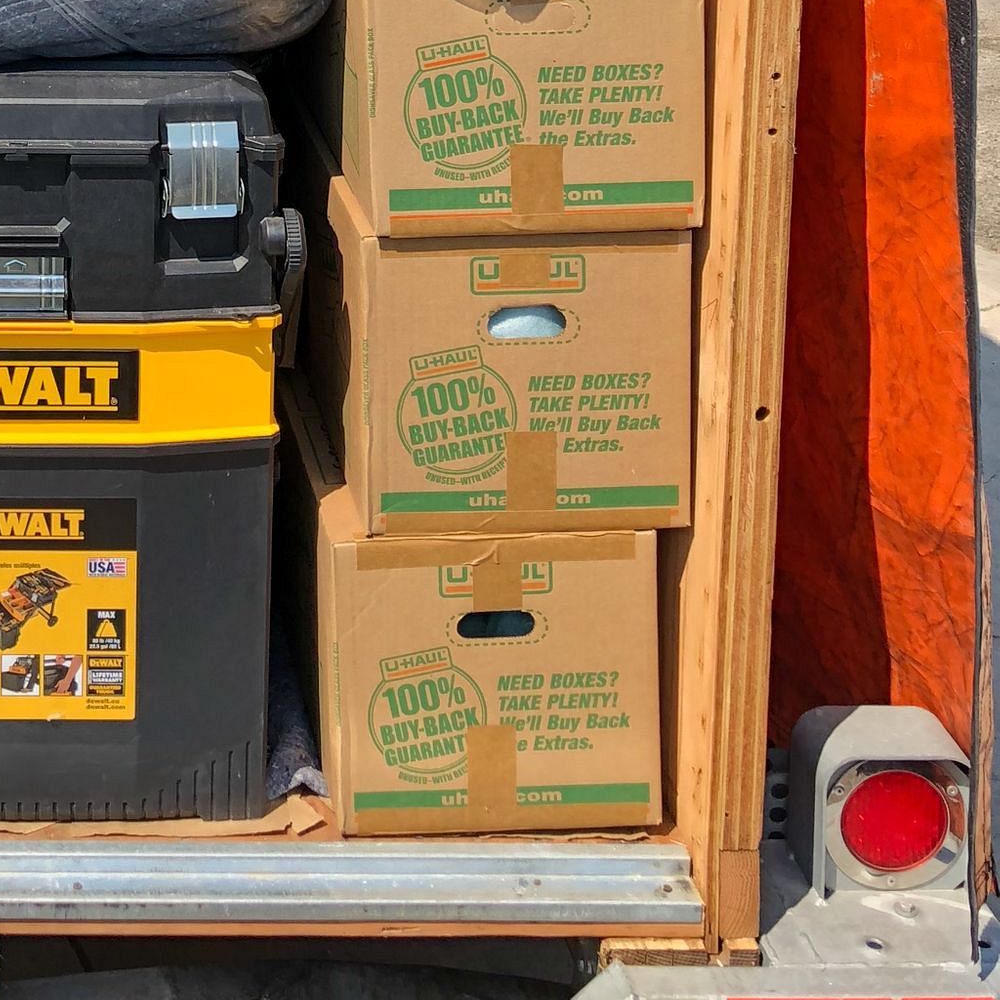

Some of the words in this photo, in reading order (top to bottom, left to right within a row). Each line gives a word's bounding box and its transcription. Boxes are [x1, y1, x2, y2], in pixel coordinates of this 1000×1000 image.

[420, 39, 485, 62] U-HAUL
[537, 66, 586, 83] NEED
[592, 63, 664, 82] BOXES?
[418, 64, 505, 111] 100%
[538, 87, 583, 105] TAKE
[588, 85, 663, 103] PLENTY!
[416, 100, 519, 140] BUY-BACK
[539, 109, 583, 126] We'll
[589, 109, 622, 129] Buy
[628, 106, 675, 123] Back
[420, 124, 525, 163] GUARANTEE
[539, 131, 568, 146] the
[575, 130, 637, 147] Extras.
[414, 349, 479, 370] U-HAUL
[527, 375, 575, 392] NEED
[580, 372, 651, 391] BOXES?
[411, 373, 496, 418] 100%
[529, 395, 573, 412] TAKE
[578, 394, 649, 411] PLENTY!
[409, 406, 510, 446] BUY-BACK
[529, 417, 572, 433] We'll
[578, 416, 615, 435] Buy
[616, 414, 662, 432] Back
[412, 433, 506, 468] GUARANTE
[562, 438, 624, 454] Extras.
[89, 562, 114, 573] USA
[97, 611, 116, 619] MAX
[384, 650, 447, 671] U-HAUL
[497, 674, 544, 691] NEED
[550, 671, 620, 690] BOXES?
[381, 674, 466, 719] 100%
[499, 694, 542, 711] TAKE
[547, 692, 618, 710] PLENTY!
[380, 707, 480, 746] BUY-BACK
[548, 714, 584, 733] Buy
[586, 712, 631, 729] Back
[384, 734, 465, 767] GUARANT
[533, 736, 594, 752] Extras.
